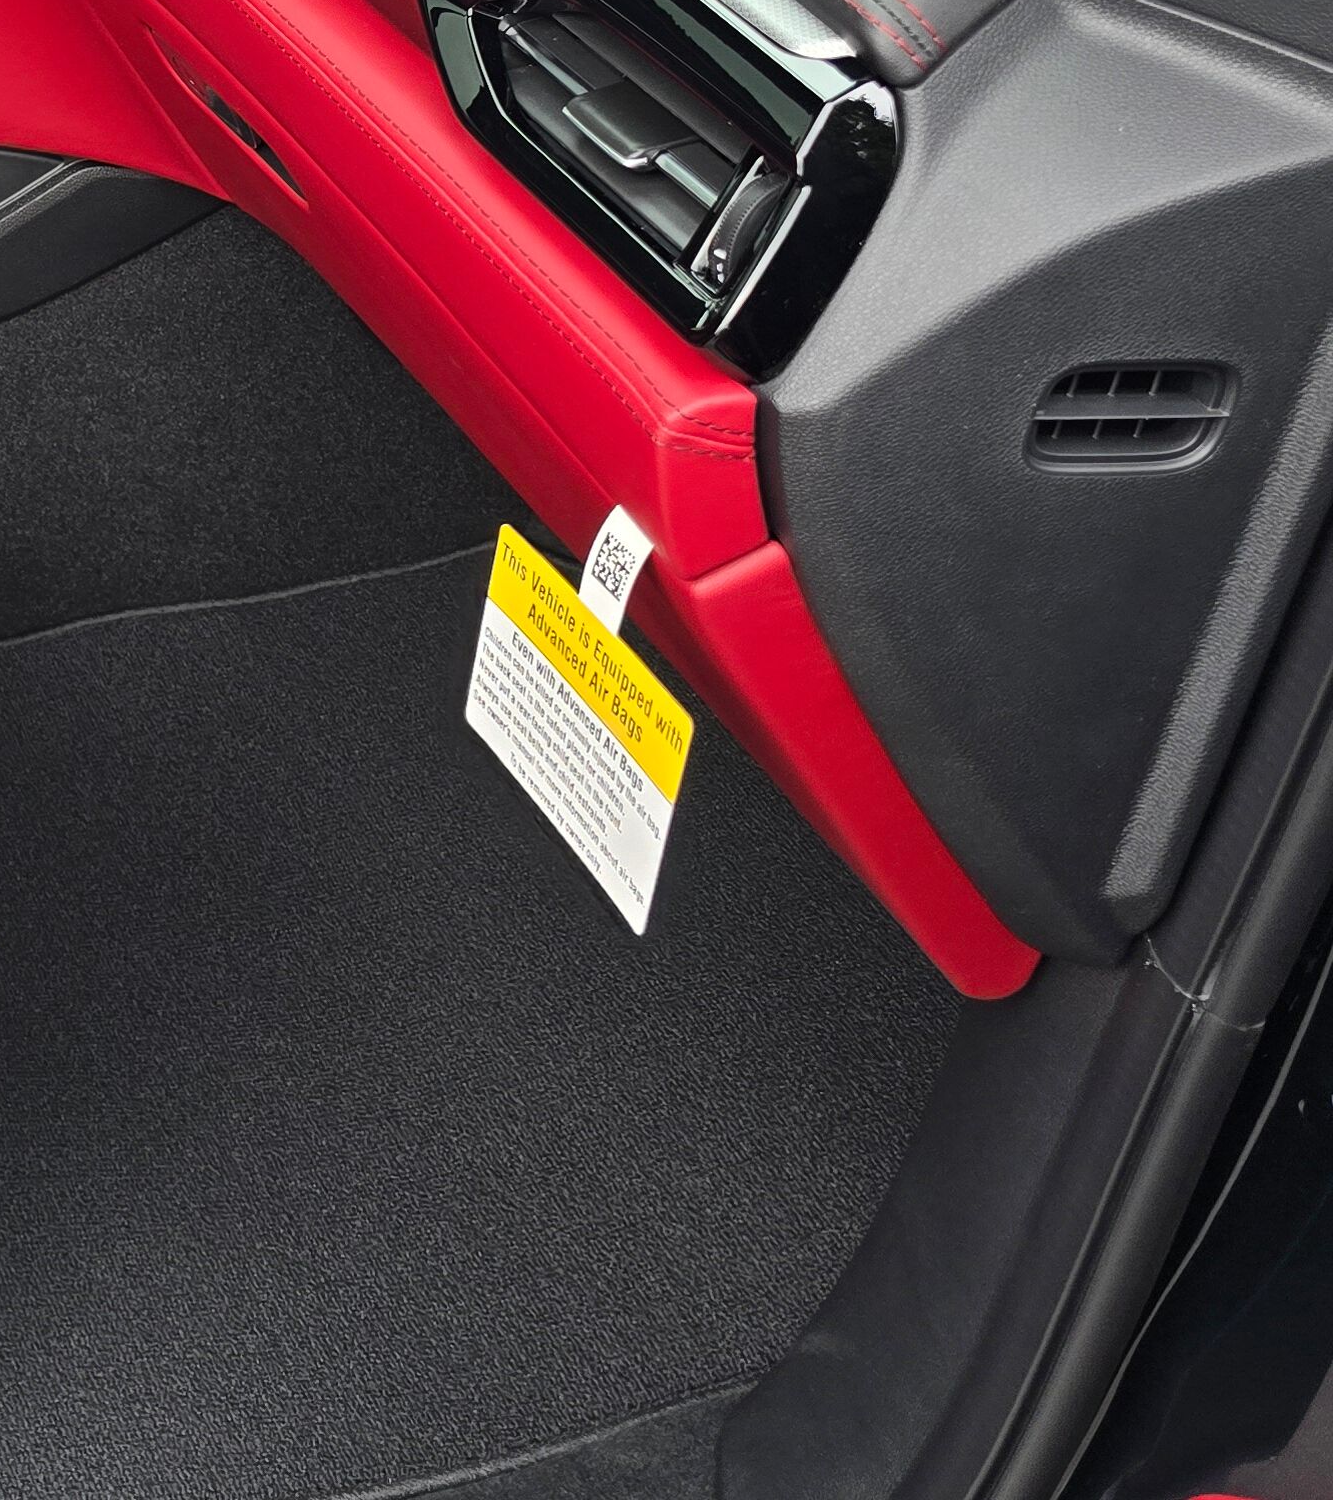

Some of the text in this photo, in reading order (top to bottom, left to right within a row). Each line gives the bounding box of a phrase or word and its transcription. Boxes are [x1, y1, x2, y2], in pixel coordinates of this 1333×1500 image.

[501, 541, 685, 756] This Vehicle is Equipped with
[511, 630, 644, 795] Even with Advanced Air Bags
[527, 601, 644, 747] Advanced Air Bags
